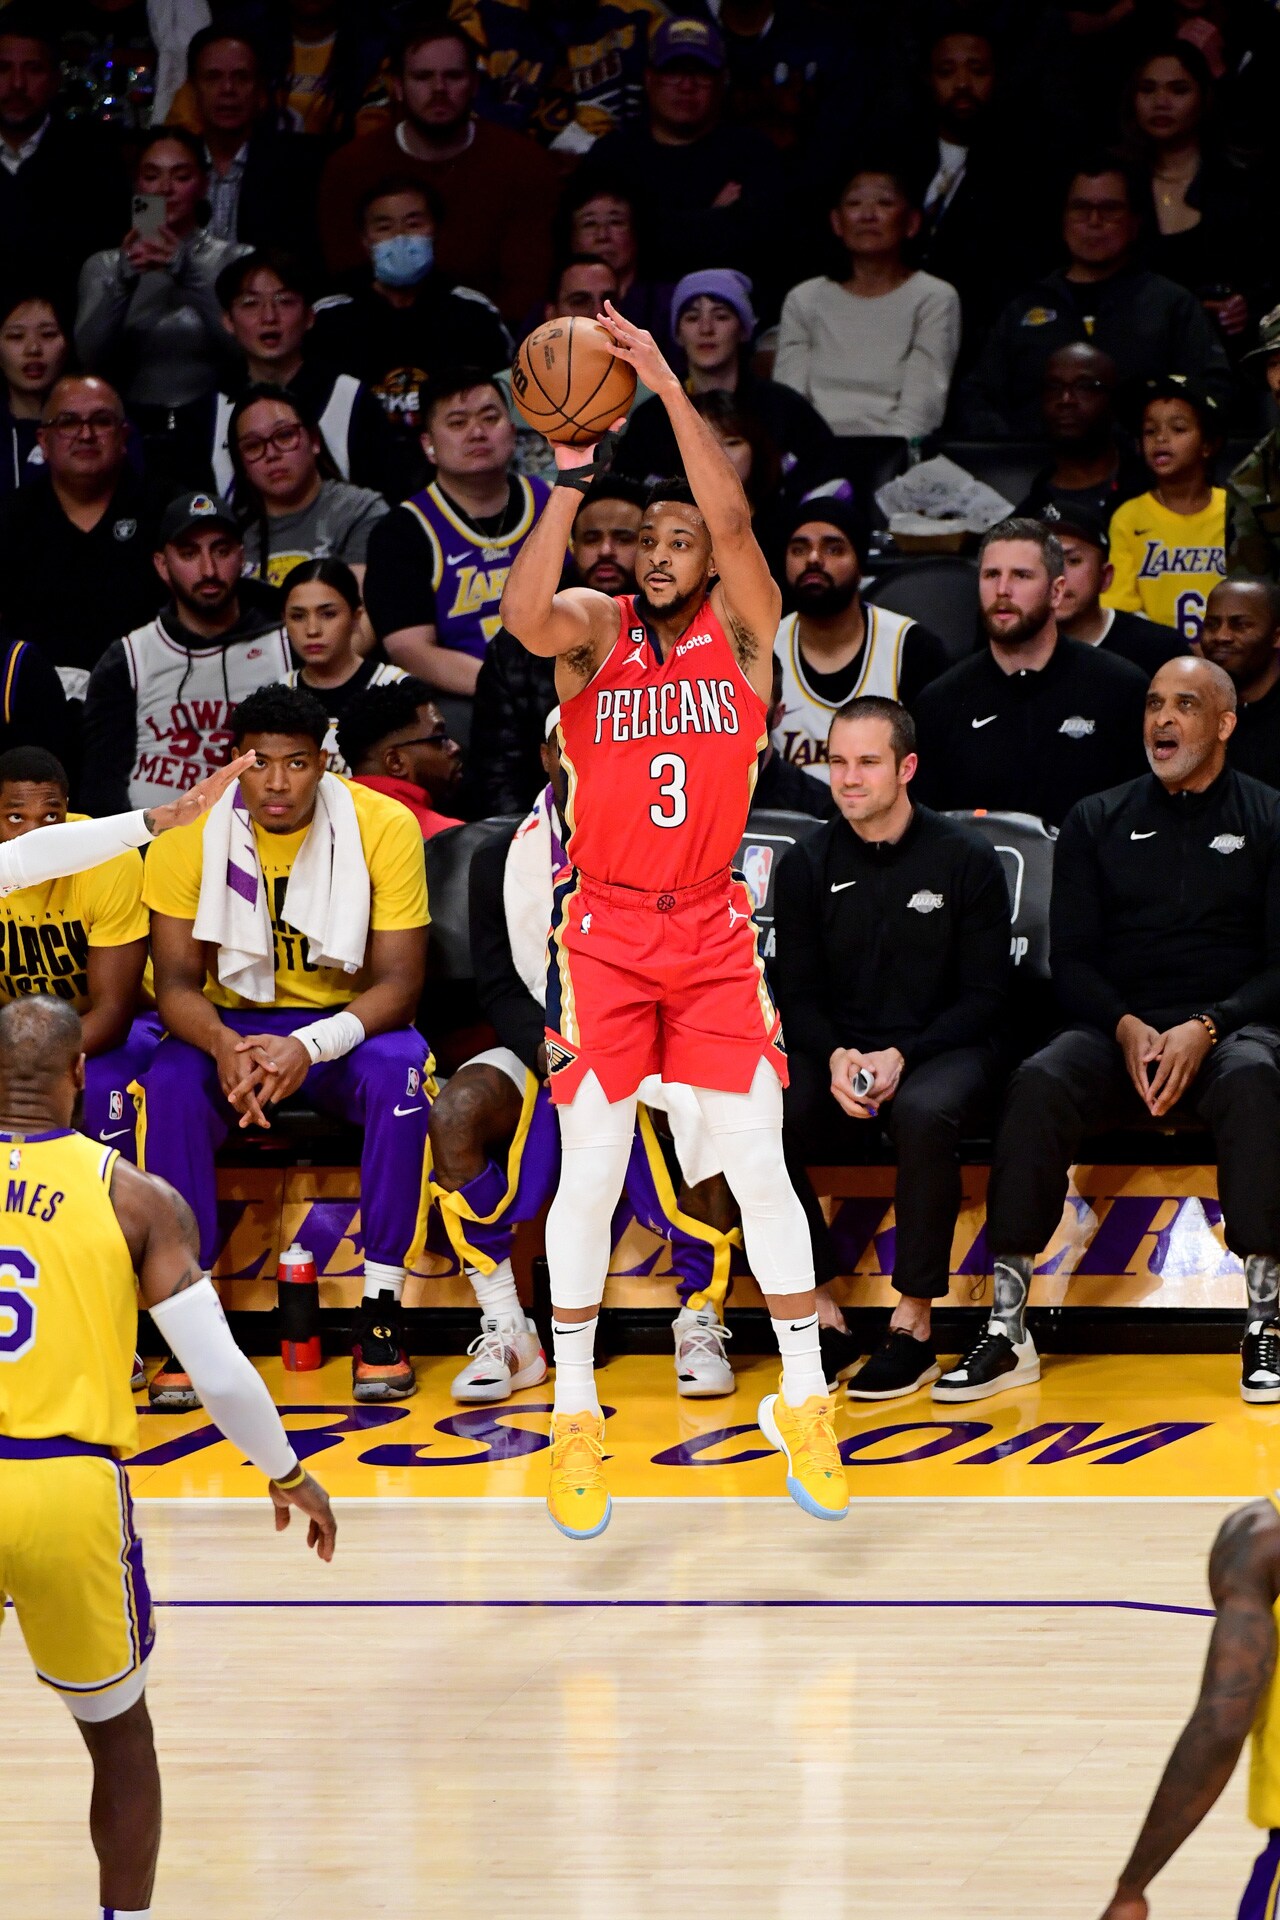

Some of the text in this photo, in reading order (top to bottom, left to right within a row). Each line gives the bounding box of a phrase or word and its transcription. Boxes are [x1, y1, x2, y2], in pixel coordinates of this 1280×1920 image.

[629, 626, 644, 643] 6
[676, 633, 713, 657] ibotta
[1175, 589, 1208, 645] 6
[594, 679, 740, 744] PELICANS
[649, 752, 688, 829] 3
[0, 1179, 65, 1223] MES
[0, 1245, 40, 1363] 6
